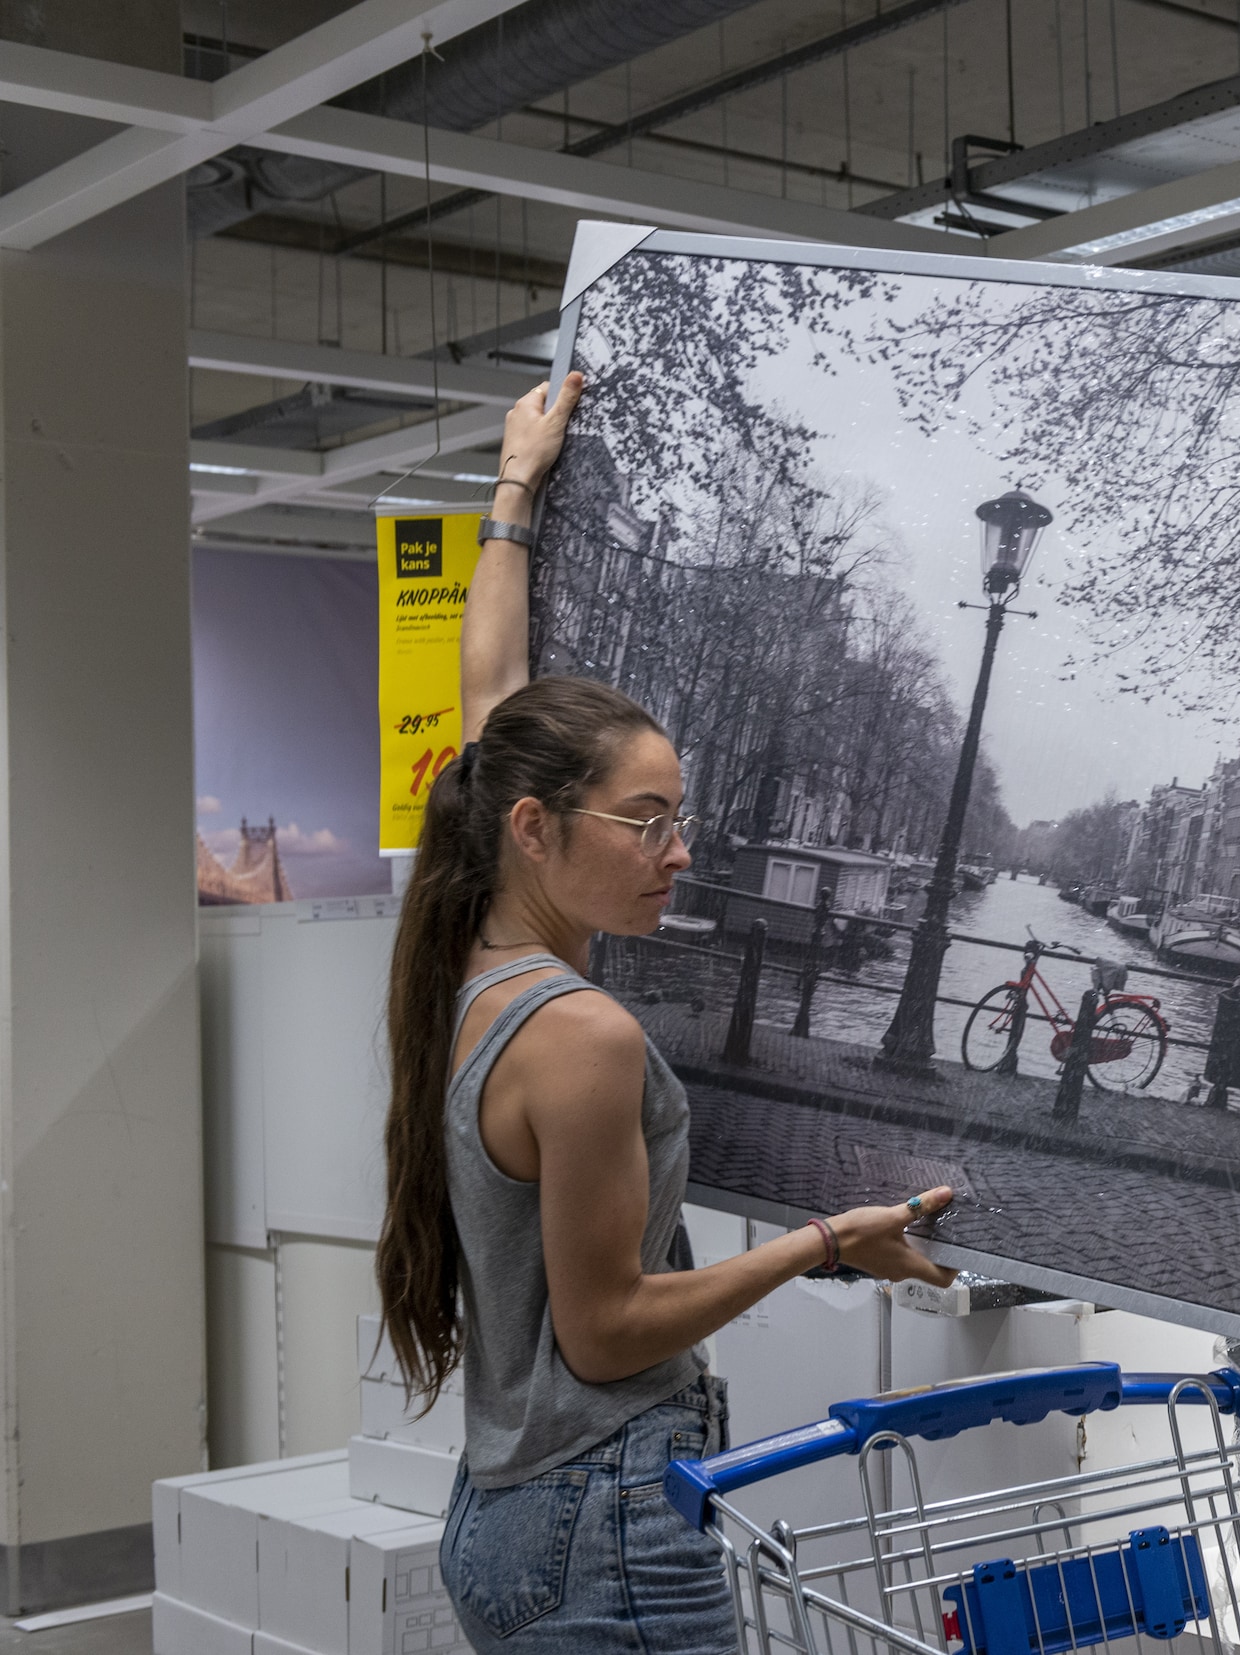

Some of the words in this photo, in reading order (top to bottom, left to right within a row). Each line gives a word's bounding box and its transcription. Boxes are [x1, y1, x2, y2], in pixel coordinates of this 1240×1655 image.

[400, 541, 424, 555] Pak
[424, 541, 437, 556] je
[401, 558, 431, 571] kans
[396, 581, 468, 607] KNOPPÄN
